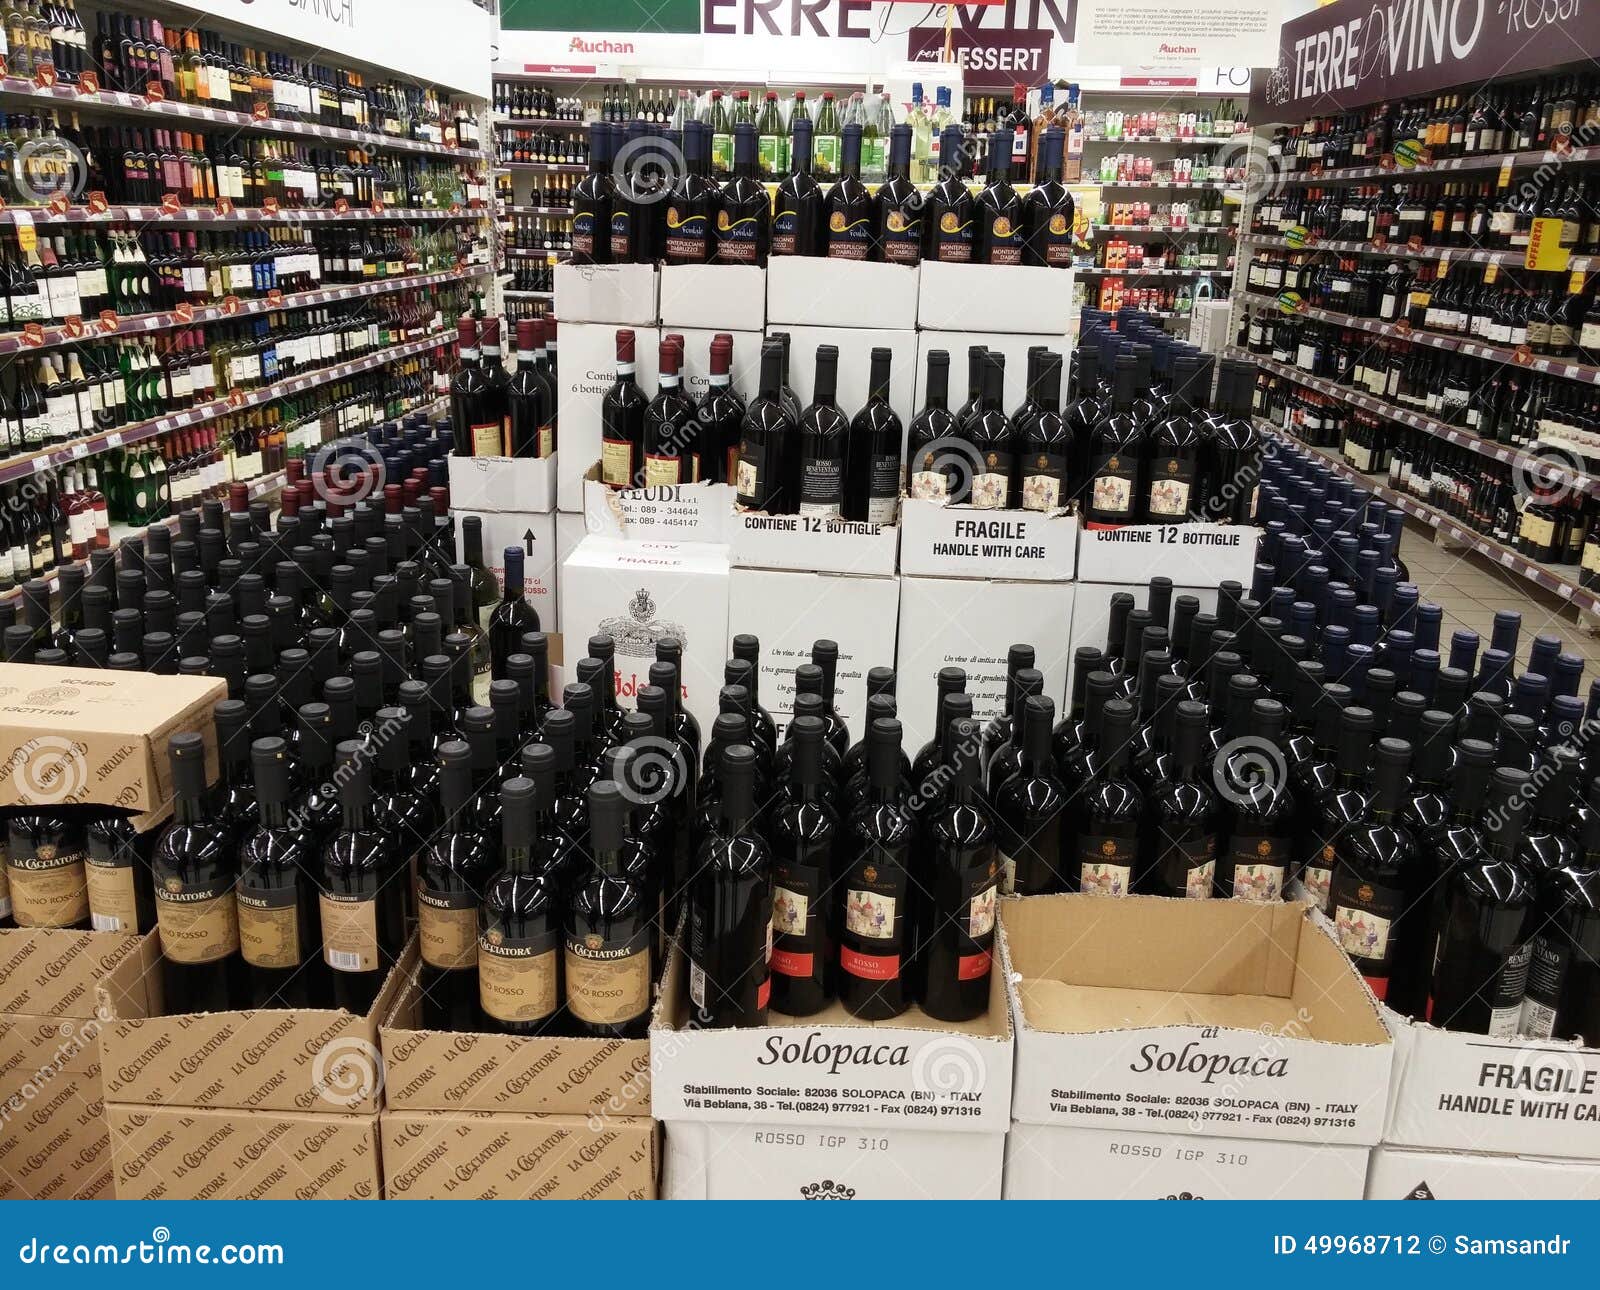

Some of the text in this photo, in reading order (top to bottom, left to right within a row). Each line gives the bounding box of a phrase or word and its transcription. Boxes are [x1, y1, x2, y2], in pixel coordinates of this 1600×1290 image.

[704, 0, 872, 39] ERRE
[568, 37, 634, 54] Auchan
[1158, 43, 1198, 55] Auchan
[1294, 0, 1485, 100] TERRE VINO
[938, 47, 1042, 72] DESSERT
[1527, 221, 1545, 269] OFFERTA
[640, 505, 657, 514] 089
[666, 506, 698, 516] 344644
[624, 517, 637, 525] ax:
[639, 516, 655, 525] 089
[745, 516, 881, 536] CONTIENE 12 BOTTIGLIE
[954, 520, 1026, 540] FRAGILE
[1097, 526, 1240, 547] CONTIENE 12 BOTTIGLIE
[933, 543, 1046, 559] HANDLE WITH CARE
[14, 858, 24, 868] LA
[25, 891, 82, 905] VINO ROSSO
[177, 929, 209, 939] ROSSO
[566, 939, 575, 951] LA
[35, 973, 49, 987] LA
[494, 986, 525, 996] ROSSO
[570, 983, 624, 997] VINO ROSSO
[757, 1032, 910, 1075] Solopaca
[232, 1061, 247, 1076] LA
[1130, 1041, 1289, 1084] Solopaca
[169, 1070, 185, 1085] LA
[1478, 1062, 1598, 1095] FRAGILE
[108, 1079, 123, 1094] LA
[557, 1079, 573, 1095] LA
[683, 1084, 982, 1102] Stabilimento Sociale: 82036 SOLOPACA (BN) ITALY
[495, 1089, 511, 1104] LA
[1050, 1089, 1359, 1115] Stabilimento Sociale: 82036 SOLOPACA (BN) ITALY
[683, 1098, 701, 1109] Via
[703, 1099, 751, 1111] Bebiana,
[753, 1100, 767, 1110] 38
[832, 1102, 870, 1113] 977921
[881, 1104, 900, 1114] Fax
[903, 1104, 938, 1117] (0824)
[940, 1105, 982, 1116] 971316
[1049, 1102, 1068, 1113] Via
[1070, 1103, 1119, 1117] Bebiana,
[1121, 1106, 1136, 1117] 38
[1201, 1111, 1242, 1123] 977921
[1252, 1113, 1273, 1124] Fax
[1275, 1114, 1312, 1127] (0824)
[1314, 1115, 1356, 1128] 971316
[1438, 1094, 1600, 1122] HANDLE WITH CA
[24, 1119, 38, 1133] LA
[754, 1131, 889, 1151] ROSSO IGP 310
[1109, 1142, 1249, 1166] ROSSO IGP 310
[172, 1164, 188, 1179] LA
[444, 1177, 460, 1192] LA
